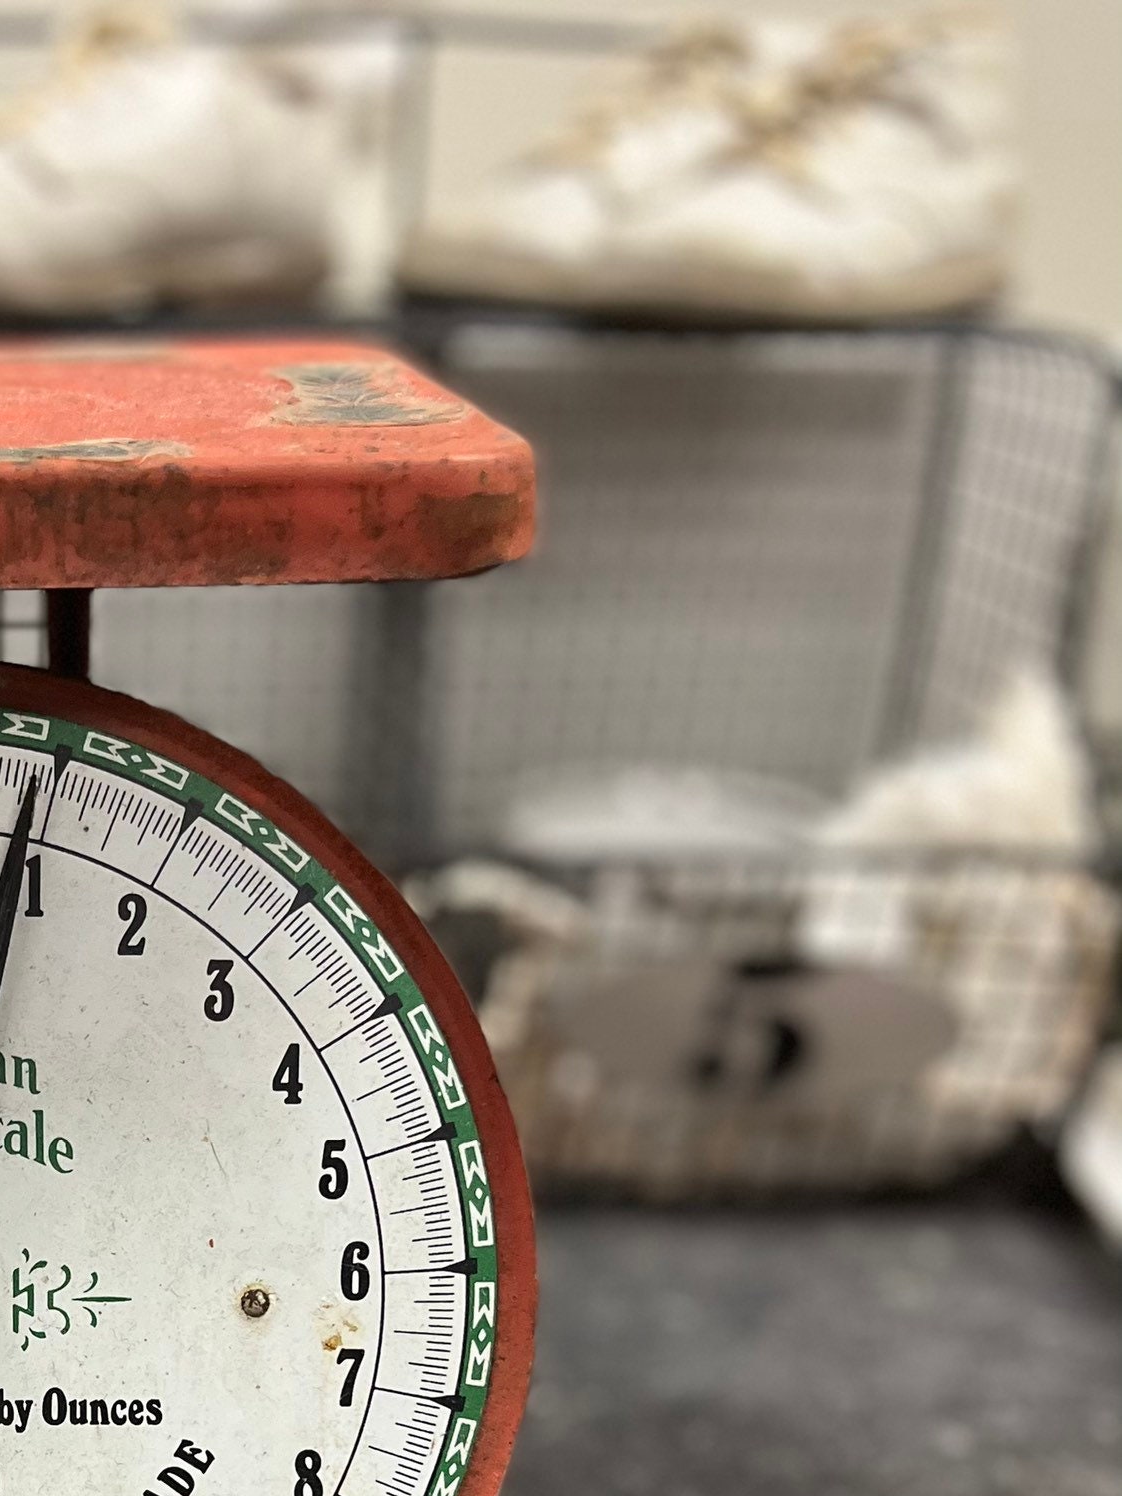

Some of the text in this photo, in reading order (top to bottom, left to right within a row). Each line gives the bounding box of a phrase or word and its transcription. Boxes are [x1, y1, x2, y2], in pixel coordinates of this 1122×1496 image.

[25, 854, 44, 917] 1
[118, 893, 147, 955] 2
[204, 959, 234, 1021] 3
[273, 1043, 303, 1104] 4
[319, 1139, 348, 1200] 5
[341, 1241, 369, 1302] 6
[42, 1387, 163, 1426] Ounces
[337, 1348, 365, 1407] 7
